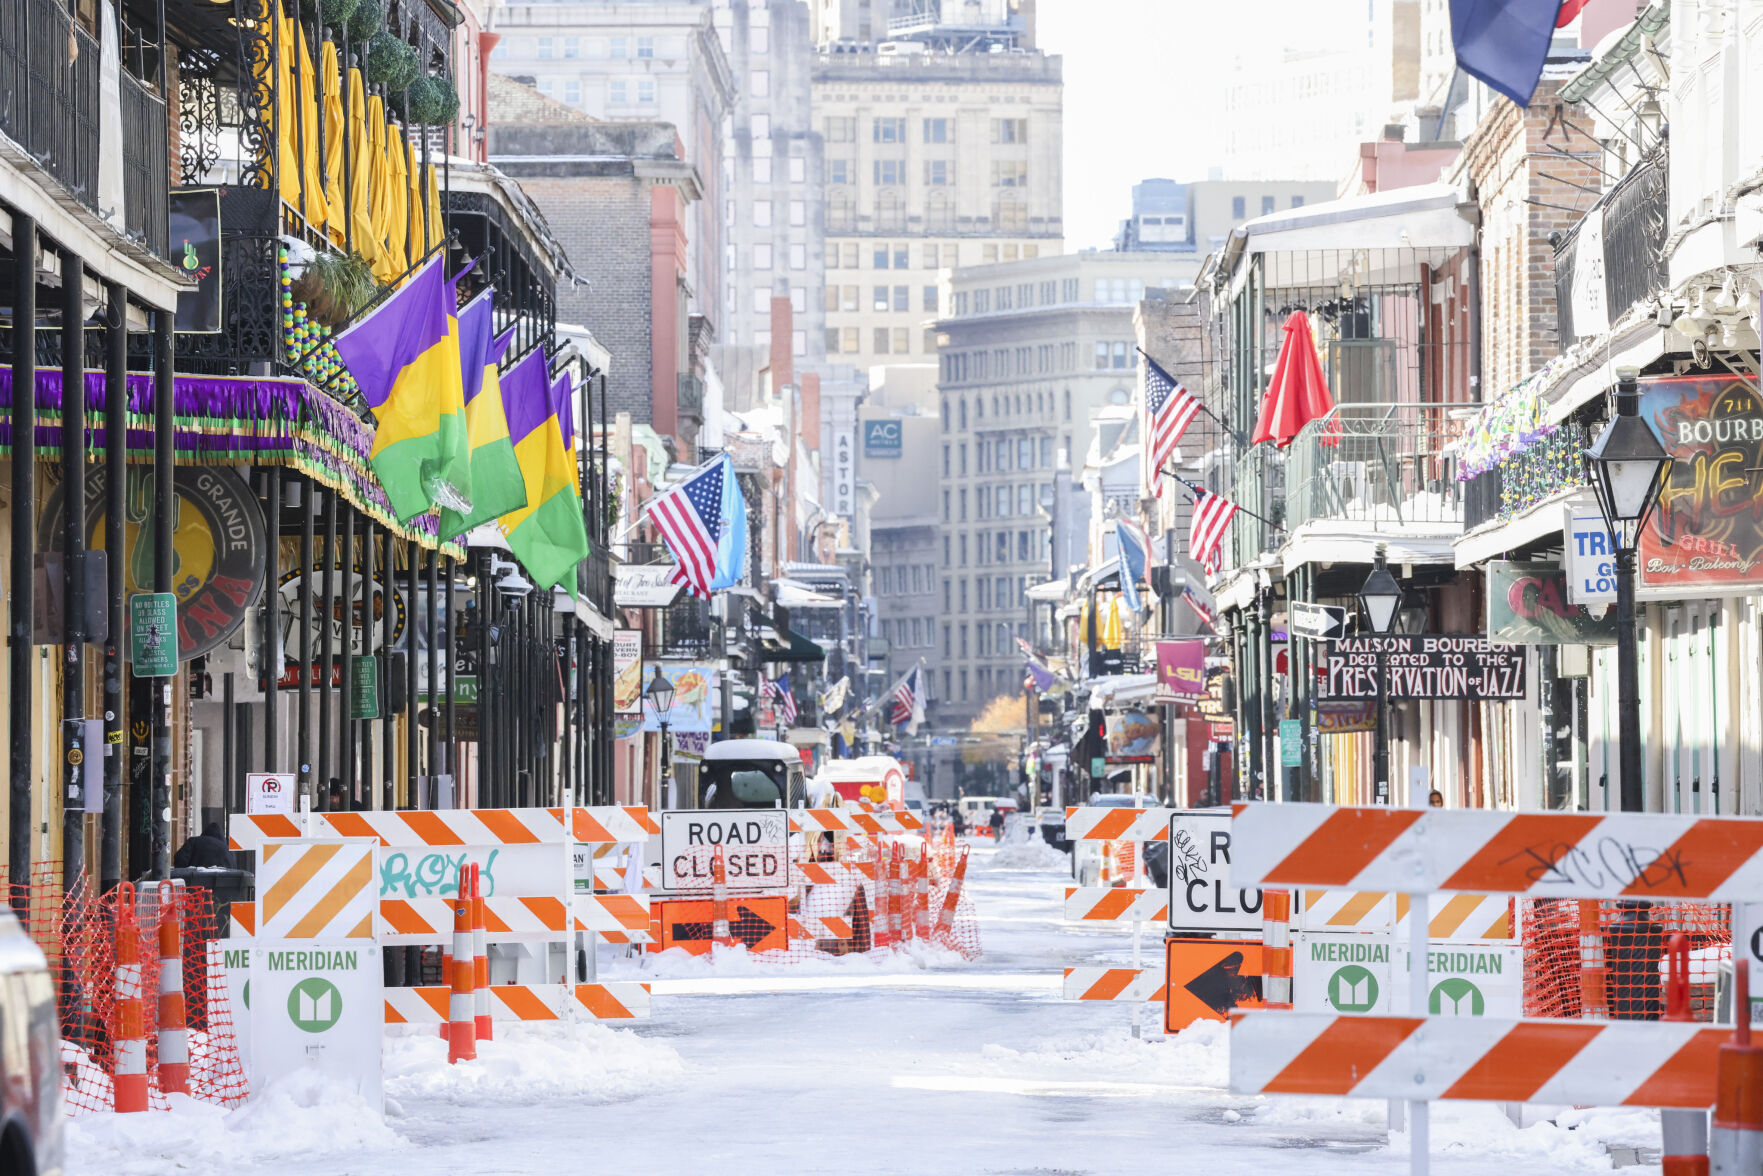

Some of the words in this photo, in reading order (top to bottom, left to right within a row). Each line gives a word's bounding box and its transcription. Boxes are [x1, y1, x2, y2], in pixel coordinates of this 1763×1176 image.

[1723, 399, 1753, 413] 711
[870, 424, 898, 439] AC
[1678, 418, 1763, 444] BOURB
[838, 435, 849, 512] ASTOR
[197, 474, 248, 551] GRANDE
[1679, 536, 1741, 558] GRILL
[1688, 556, 1757, 575] Balcony
[1334, 637, 1412, 653] MAISON
[1423, 637, 1517, 653] BOURBON
[1348, 653, 1430, 666] DEDATED
[1442, 654, 1465, 666] TO
[1476, 654, 1508, 666] THE
[1166, 665, 1202, 682] LSU
[1327, 656, 1467, 697] PRESRVATION
[1467, 677, 1482, 687] OF
[1476, 656, 1525, 697] JAZZ
[677, 738, 689, 751] YA
[692, 741, 705, 753] YA
[688, 822, 762, 845] ROAD
[1186, 879, 1264, 914] CLO
[268, 950, 358, 971] MERIDIAN
[1407, 953, 1502, 974] ERIDIAN
